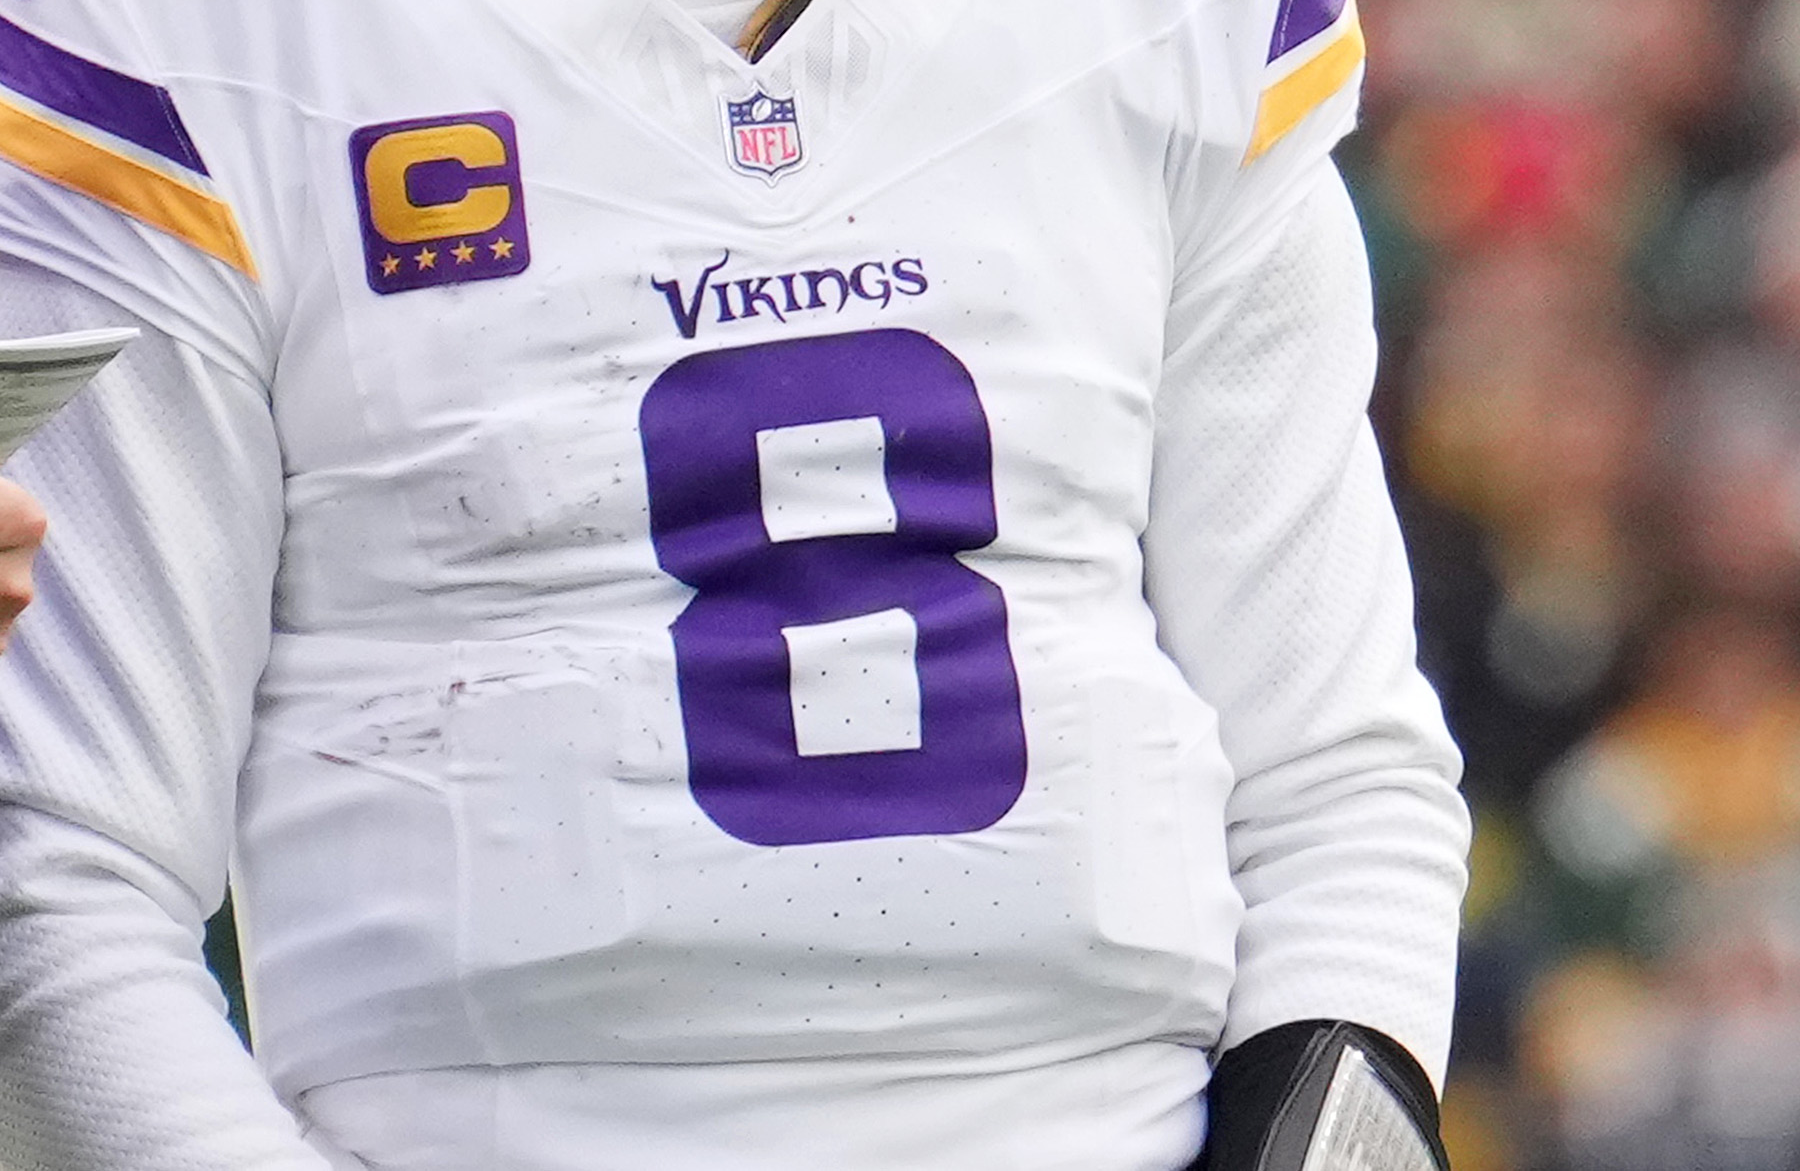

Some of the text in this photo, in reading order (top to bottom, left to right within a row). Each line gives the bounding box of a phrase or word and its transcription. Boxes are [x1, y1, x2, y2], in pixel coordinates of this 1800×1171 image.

[364, 122, 512, 245] C
[736, 126, 797, 166] NFL
[638, 327, 1029, 847] 8
